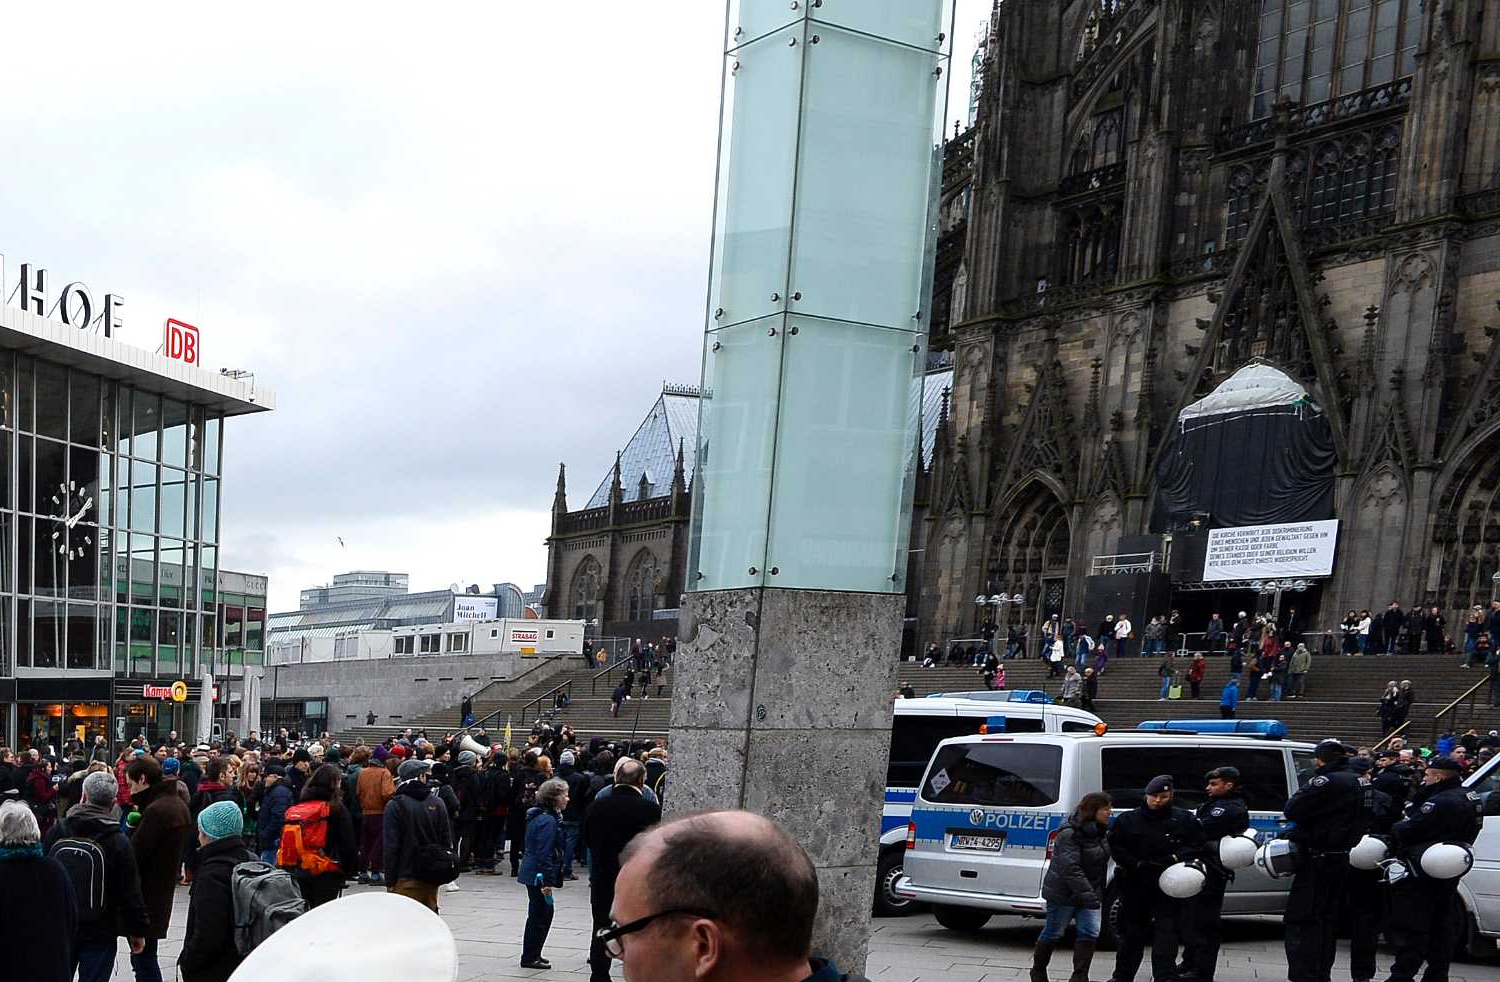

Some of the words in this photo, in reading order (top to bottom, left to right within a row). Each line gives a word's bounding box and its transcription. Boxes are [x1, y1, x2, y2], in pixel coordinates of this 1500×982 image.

[171, 327, 195, 363] DB
[456, 603, 475, 611] Joan
[456, 611, 487, 619] Mitchell
[985, 813, 1051, 830] POLIZEI
